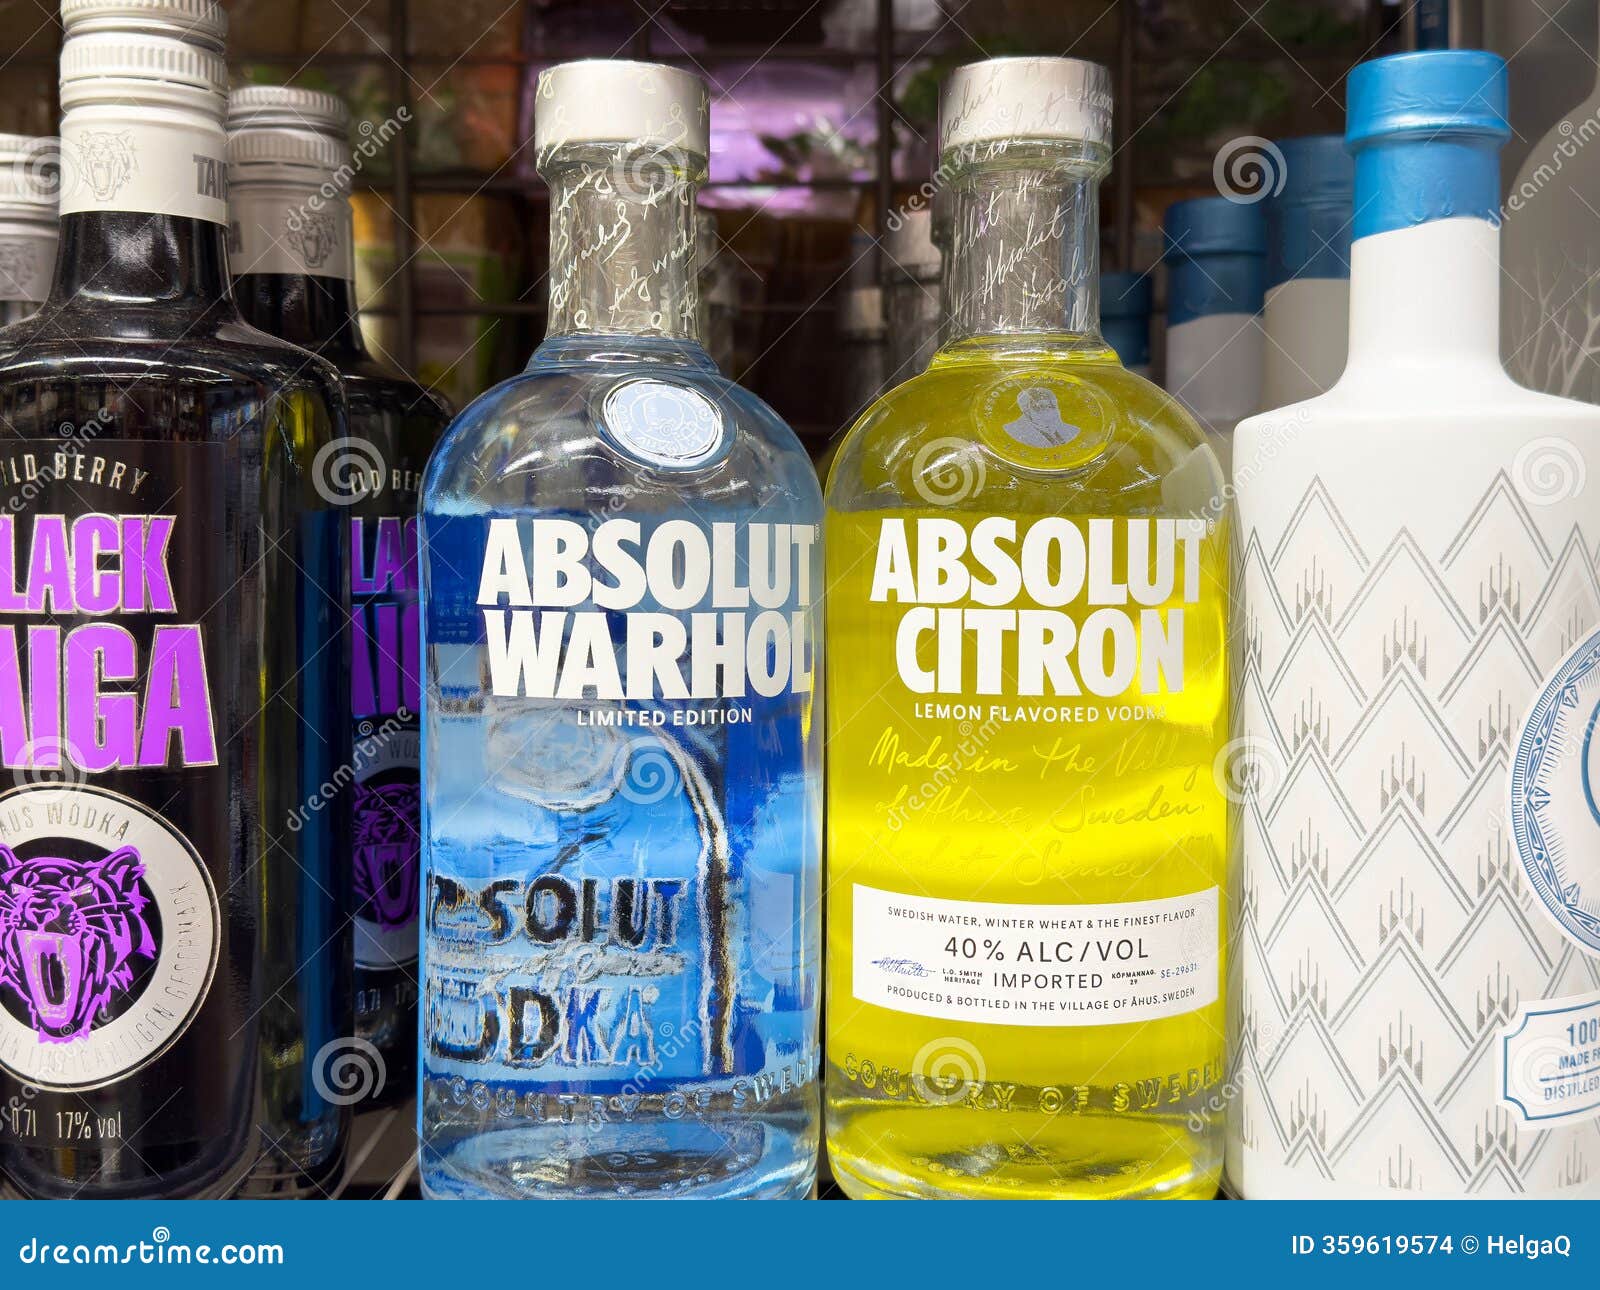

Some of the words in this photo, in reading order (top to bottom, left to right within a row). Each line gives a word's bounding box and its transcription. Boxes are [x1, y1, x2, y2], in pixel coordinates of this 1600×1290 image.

[192, 153, 229, 203] TAI
[54, 452, 149, 495] BERRY
[476, 518, 815, 610] ABSOLUT
[869, 515, 1208, 607] ABSOLUT
[482, 609, 812, 701] WARHOL
[895, 606, 1185, 698] CITRON
[577, 708, 667, 727] LIMITED
[673, 707, 753, 726] EDITION
[914, 702, 982, 721] LEMON
[989, 705, 1099, 723] FLAVORED
[869, 726, 952, 775] Made
[964, 749, 1019, 773] in
[888, 906, 934, 922] SWEDISH
[938, 914, 981, 928] WATER,
[985, 918, 1034, 929] WINTER
[1040, 919, 1083, 929] WHEAT
[1086, 919, 1094, 929] &
[1098, 918, 1120, 928] THE
[1124, 914, 1160, 928] FINEST
[1163, 908, 1195, 924] FLAVOR
[944, 936, 1005, 962] 40%
[944, 975, 981, 986] HERITAGE
[993, 972, 1104, 989] IMPORTED
[887, 985, 943, 1004] PRODUCED
[946, 994, 953, 1005] &
[957, 996, 1010, 1010] BOTTLED
[1014, 1001, 1027, 1010] IN
[1032, 1001, 1055, 1011] THE
[1060, 1000, 1109, 1011] VILLAGE
[1113, 999, 1127, 1009] OF
[1163, 987, 1195, 1003] SWEDEN
[1566, 1017, 1600, 1047] 100
[1558, 1050, 1589, 1070] MADE
[56, 1111, 92, 1140] 17%
[97, 1111, 122, 1141] vol
